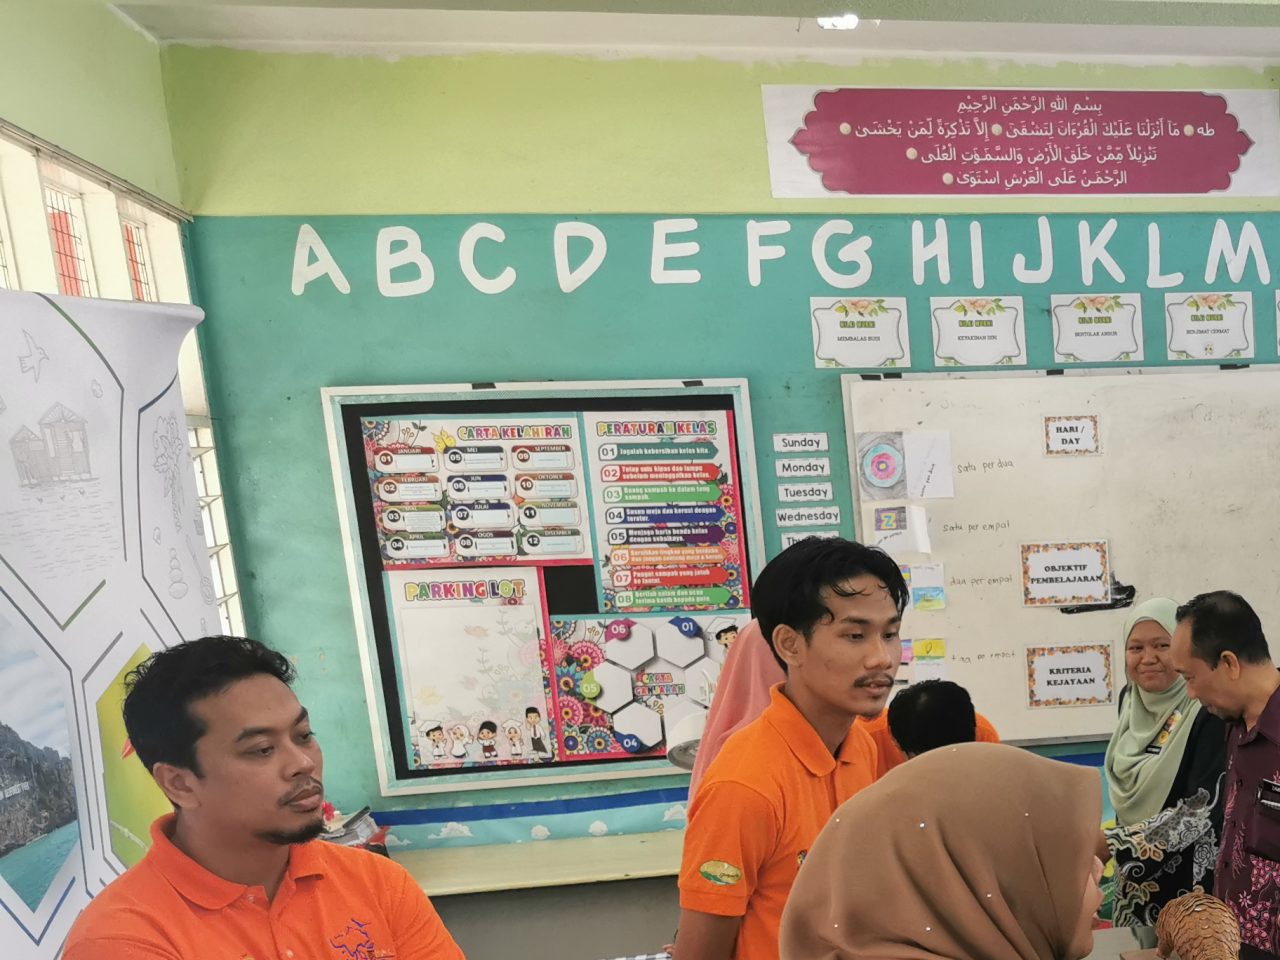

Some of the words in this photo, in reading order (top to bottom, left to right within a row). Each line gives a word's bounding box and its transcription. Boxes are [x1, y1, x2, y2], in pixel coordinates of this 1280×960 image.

[290, 224, 351, 296] A
[375, 225, 436, 299] B
[458, 221, 517, 296] C
[553, 221, 607, 293] D
[650, 218, 701, 285] E
[746, 219, 792, 287] F
[811, 219, 872, 289] G
[912, 218, 950, 285] H
[970, 221, 984, 289] I
[1012, 216, 1053, 283] J
[1078, 218, 1125, 286] K
[1147, 222, 1184, 288] L
[1204, 219, 1270, 285] M
[458, 425, 500, 440] CARTA
[500, 425, 572, 440] KELAHIRAN
[597, 421, 676, 436] PERATURAN
[676, 421, 717, 435] KELAS
[1056, 425, 1078, 434] HARI
[781, 437, 821, 448] Sunday
[1061, 437, 1081, 445] DAY
[518, 452, 530, 460] 09
[601, 448, 615, 456] 01
[379, 455, 392, 463] 01
[449, 453, 463, 461] 05
[782, 462, 825, 474] Monday
[604, 470, 618, 478] 02
[384, 484, 396, 492] 02
[453, 482, 465, 490] 06
[521, 481, 533, 489] 10
[606, 490, 620, 498] 03
[784, 487, 828, 499] Tuesday
[608, 512, 623, 520] 04
[777, 510, 839, 522] Wednesday
[527, 537, 539, 545] 12
[611, 532, 625, 541] 05
[391, 541, 404, 549] 04
[613, 553, 627, 561] 06
[1044, 564, 1088, 573] OBJEKTIF
[615, 575, 629, 583] 07
[1030, 574, 1104, 585] PEMBELAJARAN
[404, 580, 487, 602] PARKING
[489, 578, 526, 599] LOT
[617, 595, 632, 604] 08
[611, 624, 626, 635] 06
[681, 621, 694, 632] 01
[1049, 666, 1092, 675] KRITERIA
[1046, 676, 1096, 687] KEJAYAAN
[582, 683, 597, 694] 05
[623, 738, 638, 749] 04
